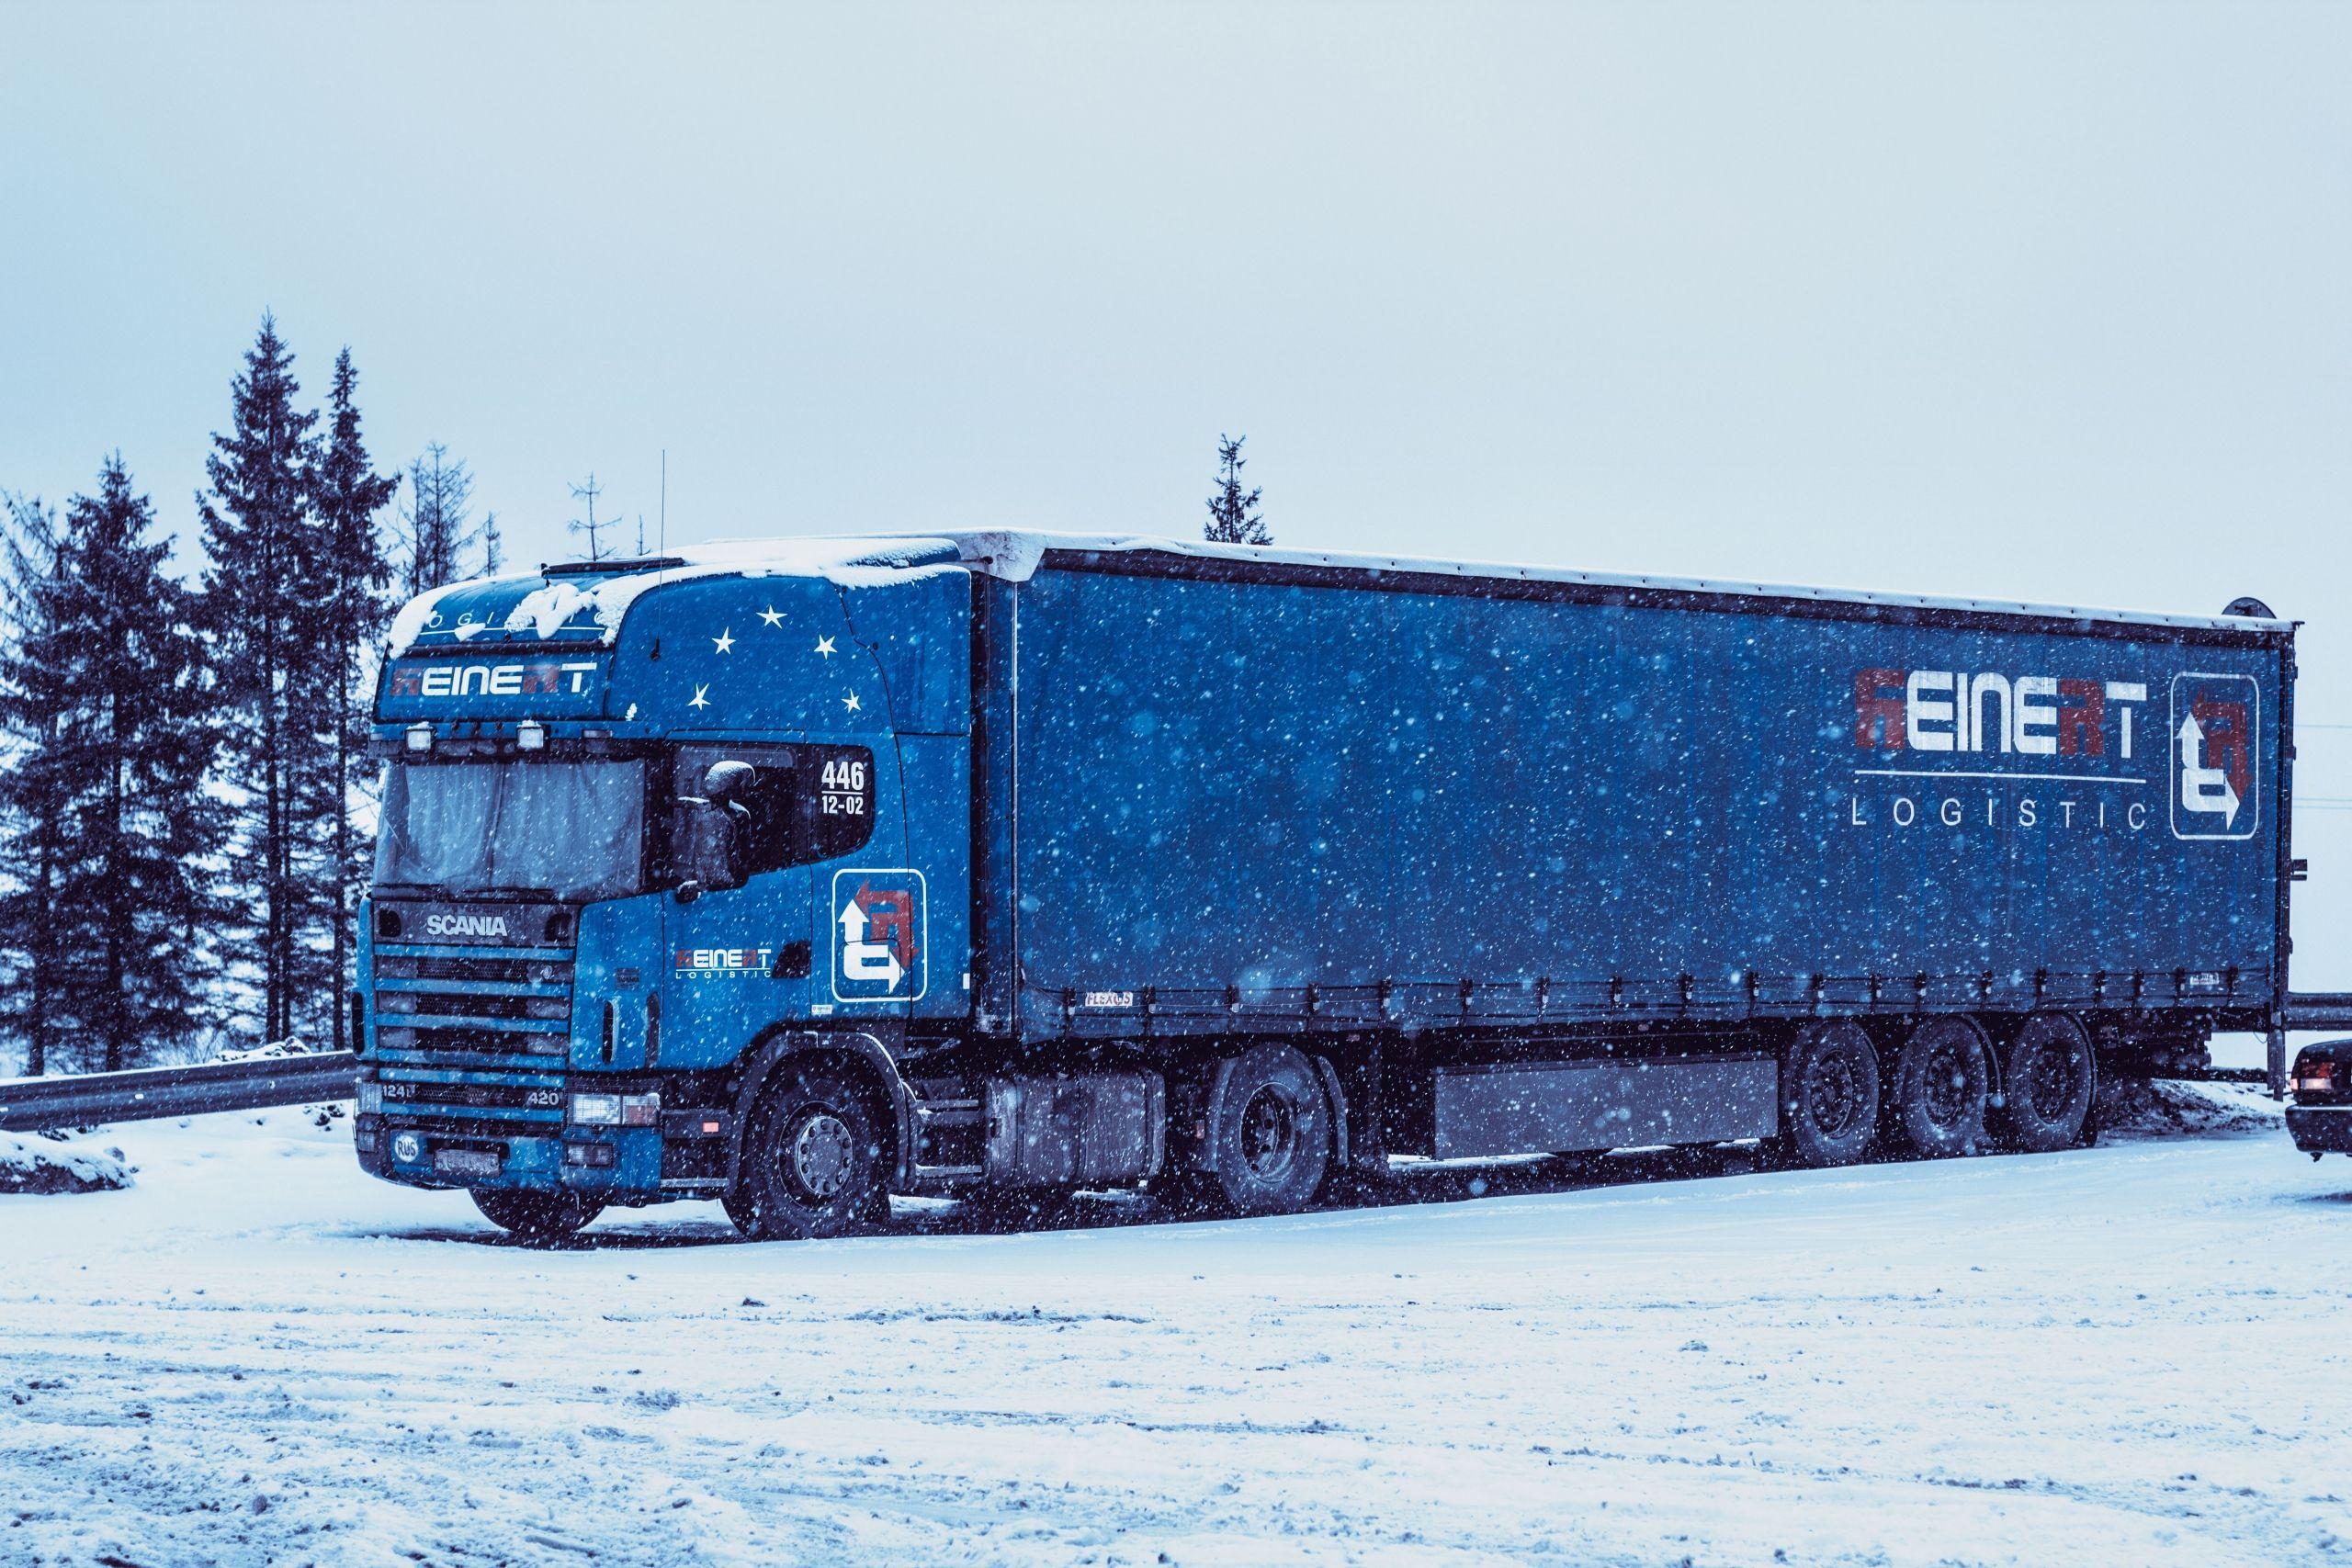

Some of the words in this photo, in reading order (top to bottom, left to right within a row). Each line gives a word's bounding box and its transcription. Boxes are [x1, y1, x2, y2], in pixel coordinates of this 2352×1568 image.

[390, 662, 597, 696] REINERT
[1854, 668, 2147, 759] REINERT
[821, 761, 865, 790] 446
[821, 795, 864, 815] 12-02
[1851, 796, 2146, 830] LOGISTIC
[426, 914, 507, 936] SCANIA
[675, 949, 772, 968] REINERT
[675, 971, 772, 979] LOGISTIC
[526, 1091, 560, 1105] 420
[398, 1140, 416, 1156] RUS
